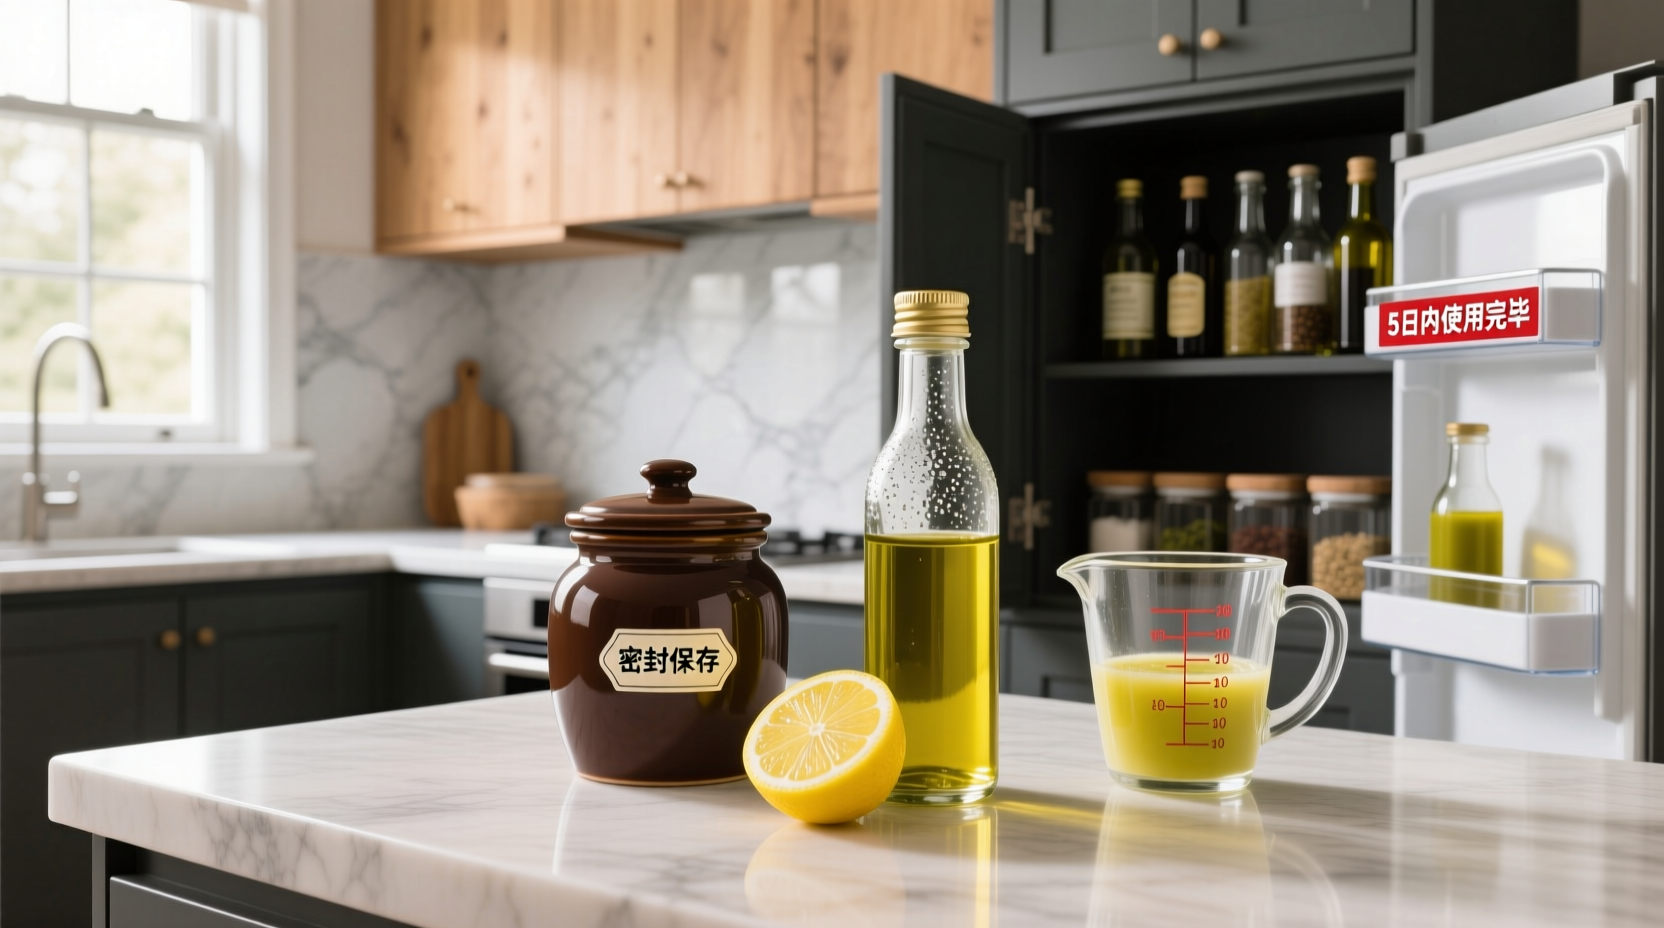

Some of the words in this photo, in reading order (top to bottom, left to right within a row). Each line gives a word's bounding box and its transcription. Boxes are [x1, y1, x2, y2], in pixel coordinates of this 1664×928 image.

[1387, 296, 1530, 336] 5日内使用完毕
[618, 645, 720, 674] 密封保存
[1214, 652, 1229, 665] 10
[1213, 676, 1229, 688] 10
[1213, 697, 1228, 709] 10
[1211, 737, 1225, 749] 10
